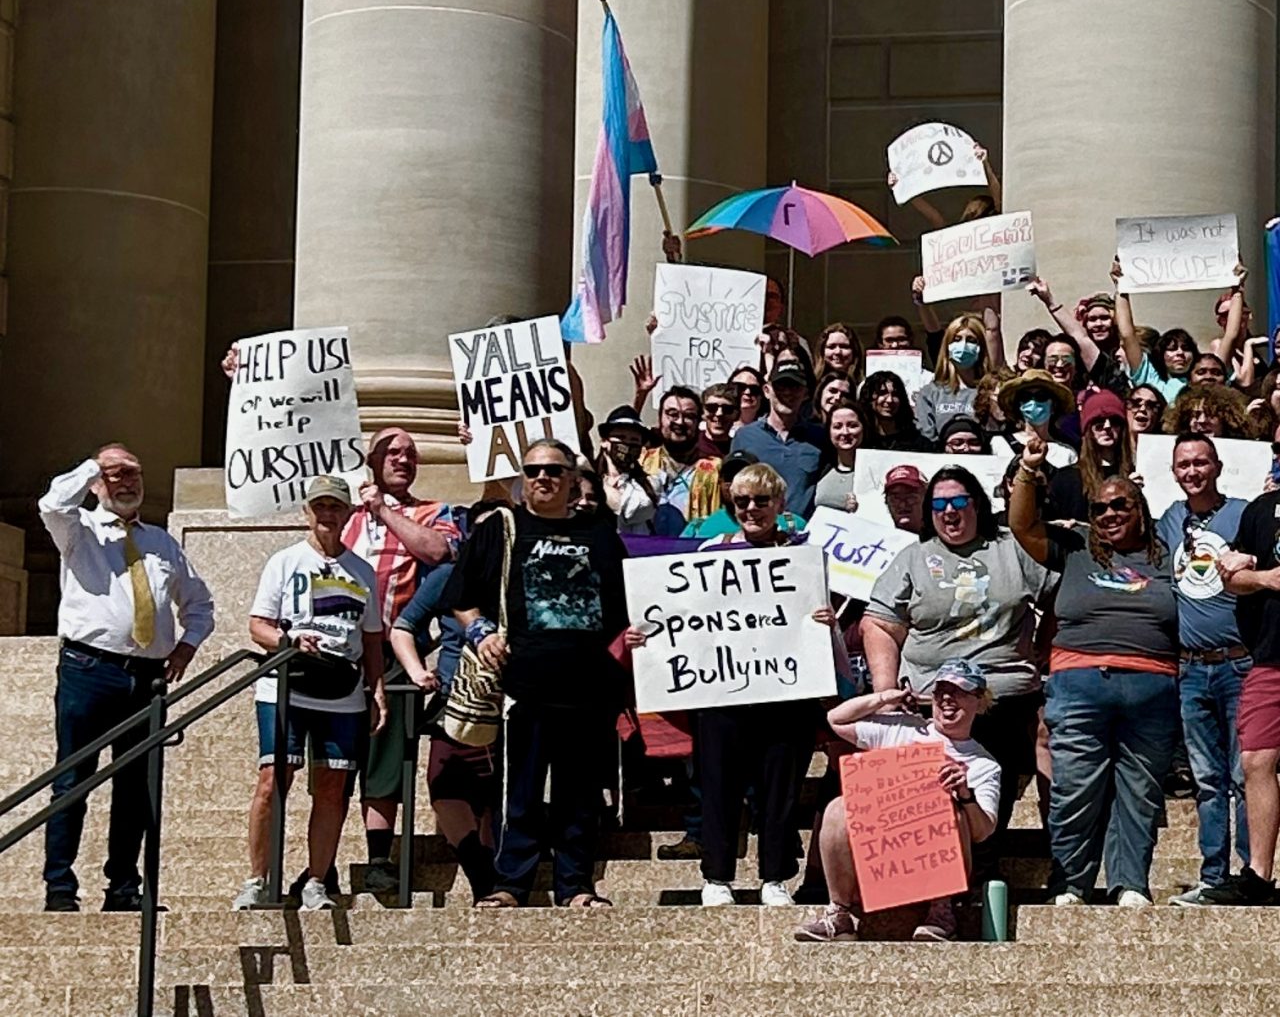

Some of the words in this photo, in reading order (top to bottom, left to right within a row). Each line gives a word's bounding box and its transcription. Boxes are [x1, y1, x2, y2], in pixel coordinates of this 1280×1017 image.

[1130, 222, 1156, 244] It
[1165, 226, 1196, 244] was
[1201, 218, 1225, 244] not
[659, 290, 760, 333] JUSTICE
[236, 339, 298, 385] HELP
[307, 337, 352, 374] US!
[688, 336, 725, 359] FOR
[269, 395, 296, 409] we
[299, 378, 342, 403] will
[461, 366, 570, 428] MEANS
[257, 410, 312, 435] help
[822, 522, 895, 570] Justi
[665, 557, 798, 597] STATE
[843, 756, 888, 778] Stop
[896, 746, 943, 763] HATE
[844, 782, 873, 799] Stop
[846, 801, 872, 820] Stop
[859, 820, 958, 862] IMPEACH
[869, 845, 959, 882] WALTERS
